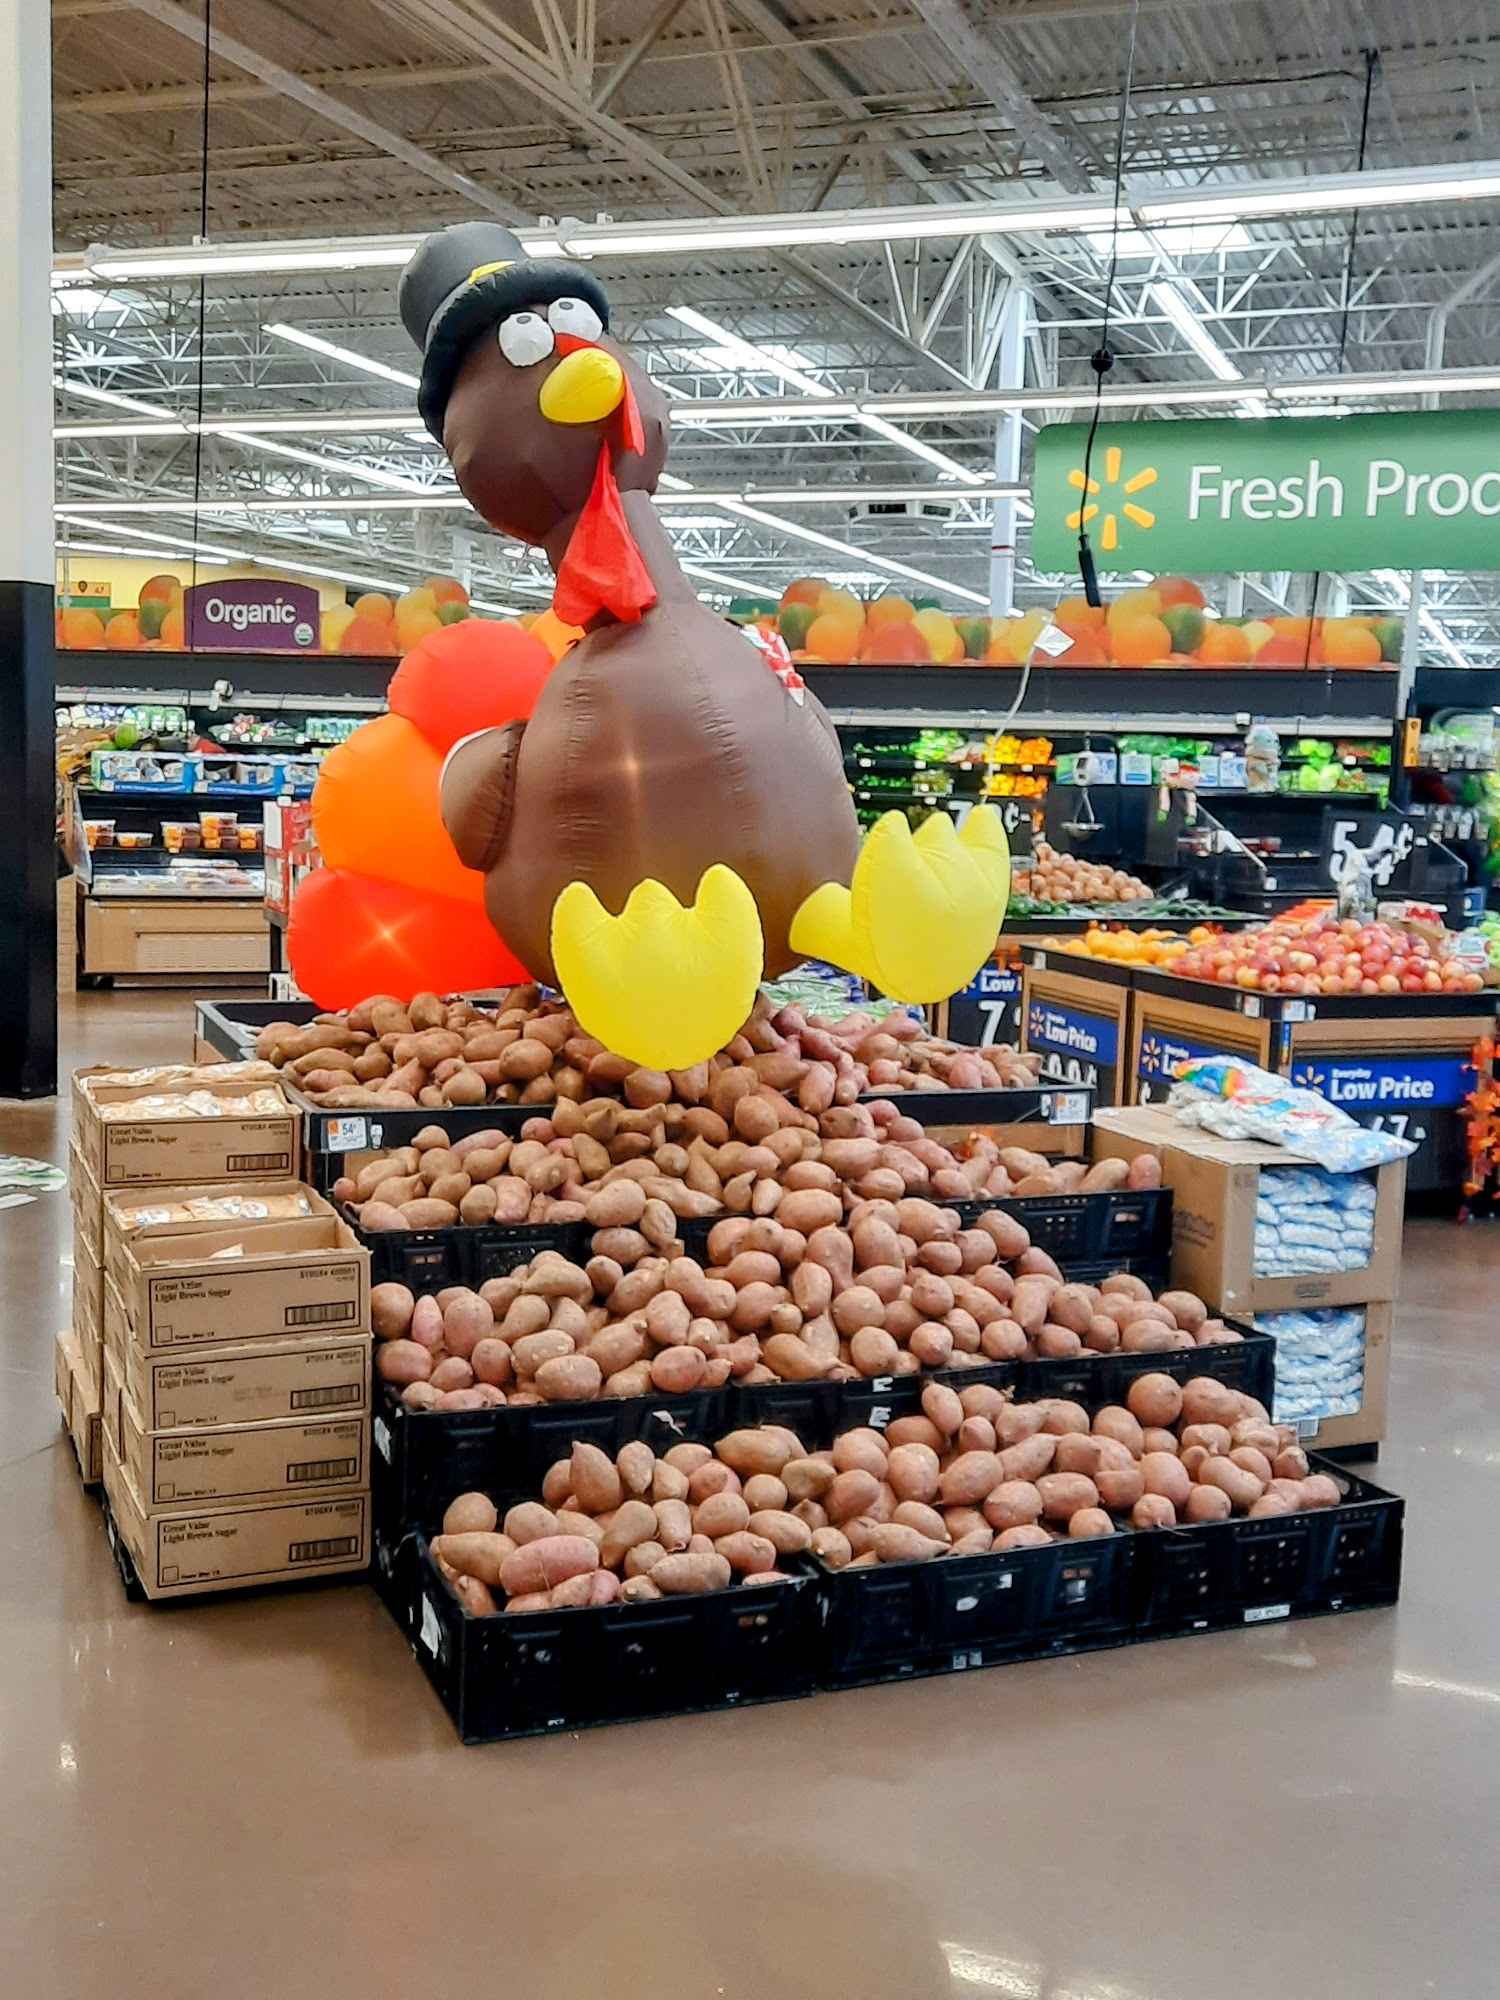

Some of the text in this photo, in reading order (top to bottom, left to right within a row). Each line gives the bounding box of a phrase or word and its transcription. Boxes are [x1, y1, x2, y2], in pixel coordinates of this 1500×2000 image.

[1188, 458, 1344, 520] Fresh
[205, 597, 296, 631] Organic
[980, 974, 1016, 993] Low
[1330, 1075, 1434, 1101] Low Price
